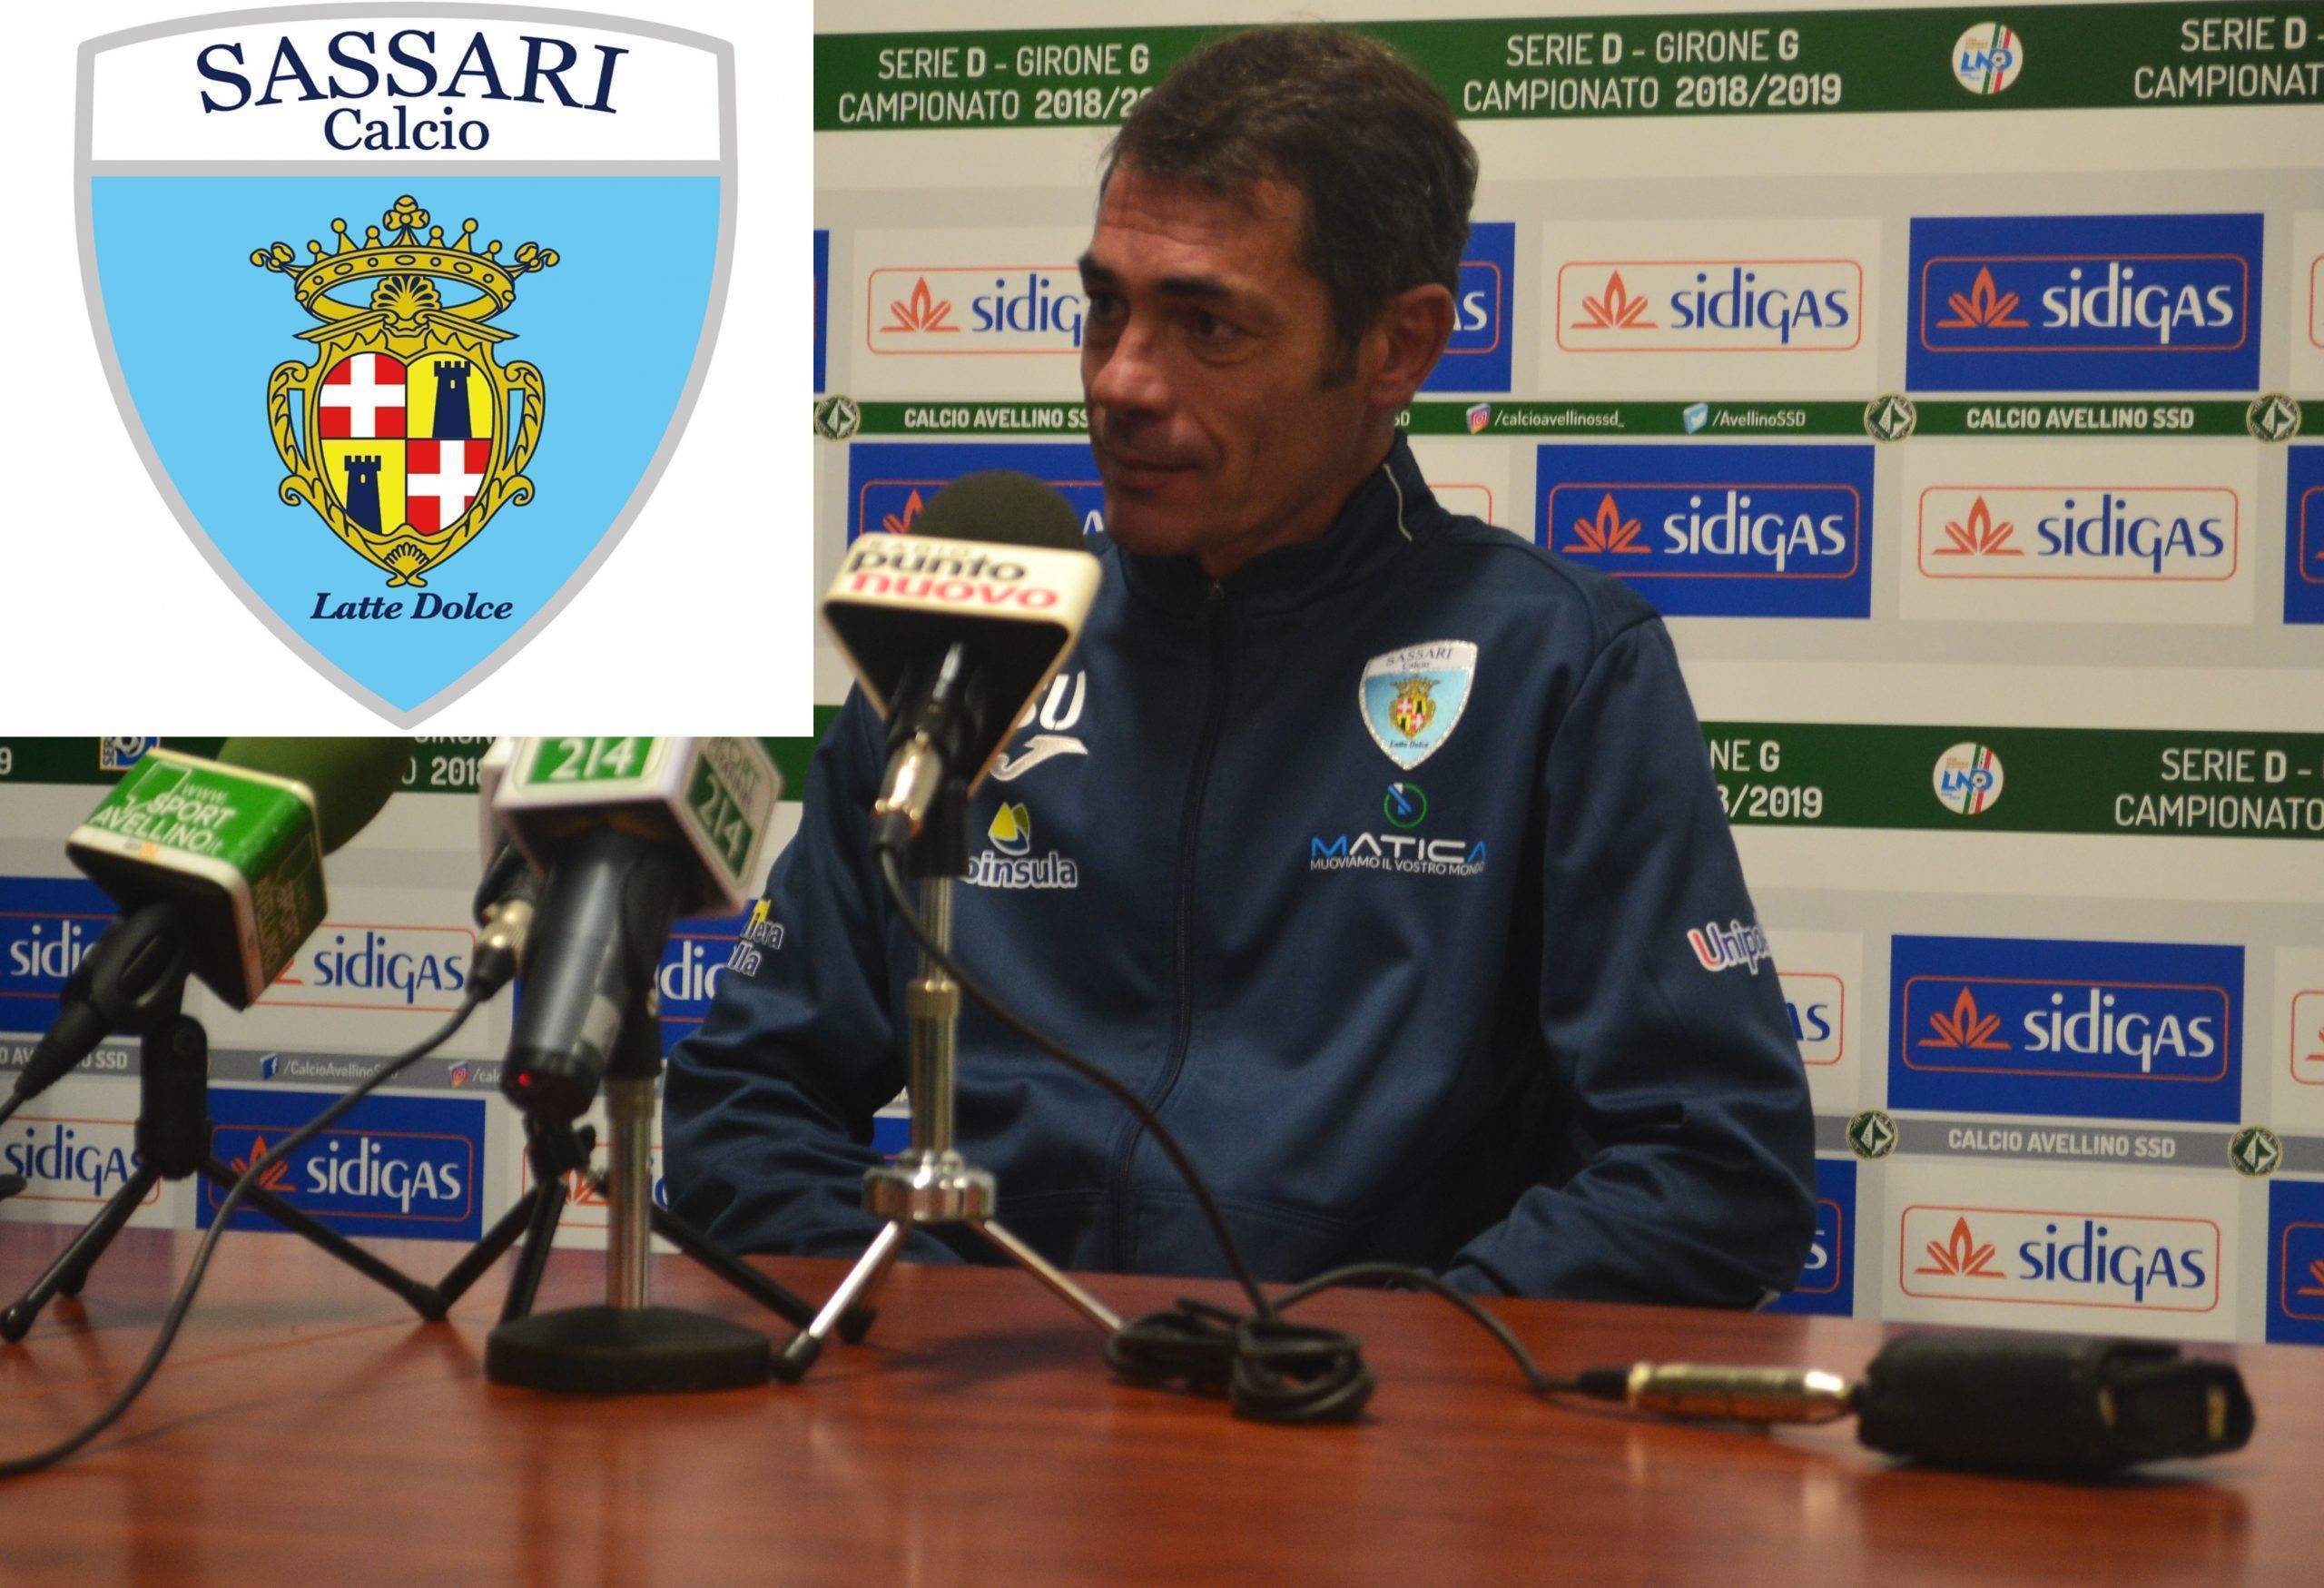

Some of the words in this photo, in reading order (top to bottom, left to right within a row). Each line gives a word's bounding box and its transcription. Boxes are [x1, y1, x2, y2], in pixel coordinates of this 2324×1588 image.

[1506, 33, 1593, 66] SERIE
[1602, 33, 1623, 64] D
[1656, 29, 1770, 64] GIRONE
[1777, 29, 1799, 61] G
[2181, 16, 2275, 52] SERIE
[2285, 16, 2307, 50] D
[878, 47, 960, 80] SERIE
[967, 47, 987, 77] D
[1016, 44, 1122, 77] GIRONE
[1129, 43, 1149, 75] G
[1463, 76, 1659, 113] CAMPIONATO
[1675, 72, 1843, 109] 2018/2019
[2134, 61, 2324, 100] CAMPIONAT
[838, 90, 1019, 123] CAMPIONATO
[1034, 86, 1153, 120] 2018/2
[904, 408, 970, 429] CALCIO
[973, 408, 1063, 429] AVELLINO
[1068, 409, 1088, 429] SS
[1712, 409, 1806, 429] /AvellinoSSD
[1966, 407, 2038, 430] CALCIO
[2045, 407, 2149, 429] AVELLINO
[2153, 407, 2195, 429] SSD
[849, 550, 1026, 582] punto
[852, 572, 1058, 609] nuovo
[1386, 647, 1453, 667] SASSARI
[1759, 739, 1780, 773] G
[2161, 747, 2256, 782] SERIE
[2264, 749, 2287, 784] D
[146, 791, 237, 830] SPORT
[1717, 783, 1823, 819] /2019
[2114, 793, 2324, 831] CAMPIONATO
[1310, 855, 1380, 872] MUOVIAMO
[1382, 858, 1392, 872] IL
[1393, 860, 1446, 874] VOSTRO
[1311, 832, 1487, 863] MATICA
[95, 1050, 128, 1070] SSD
[1948, 1128, 2023, 1152] CALCIO
[2026, 1131, 2130, 1157] AVELLINO
[2134, 1136, 2176, 1159] SSD
